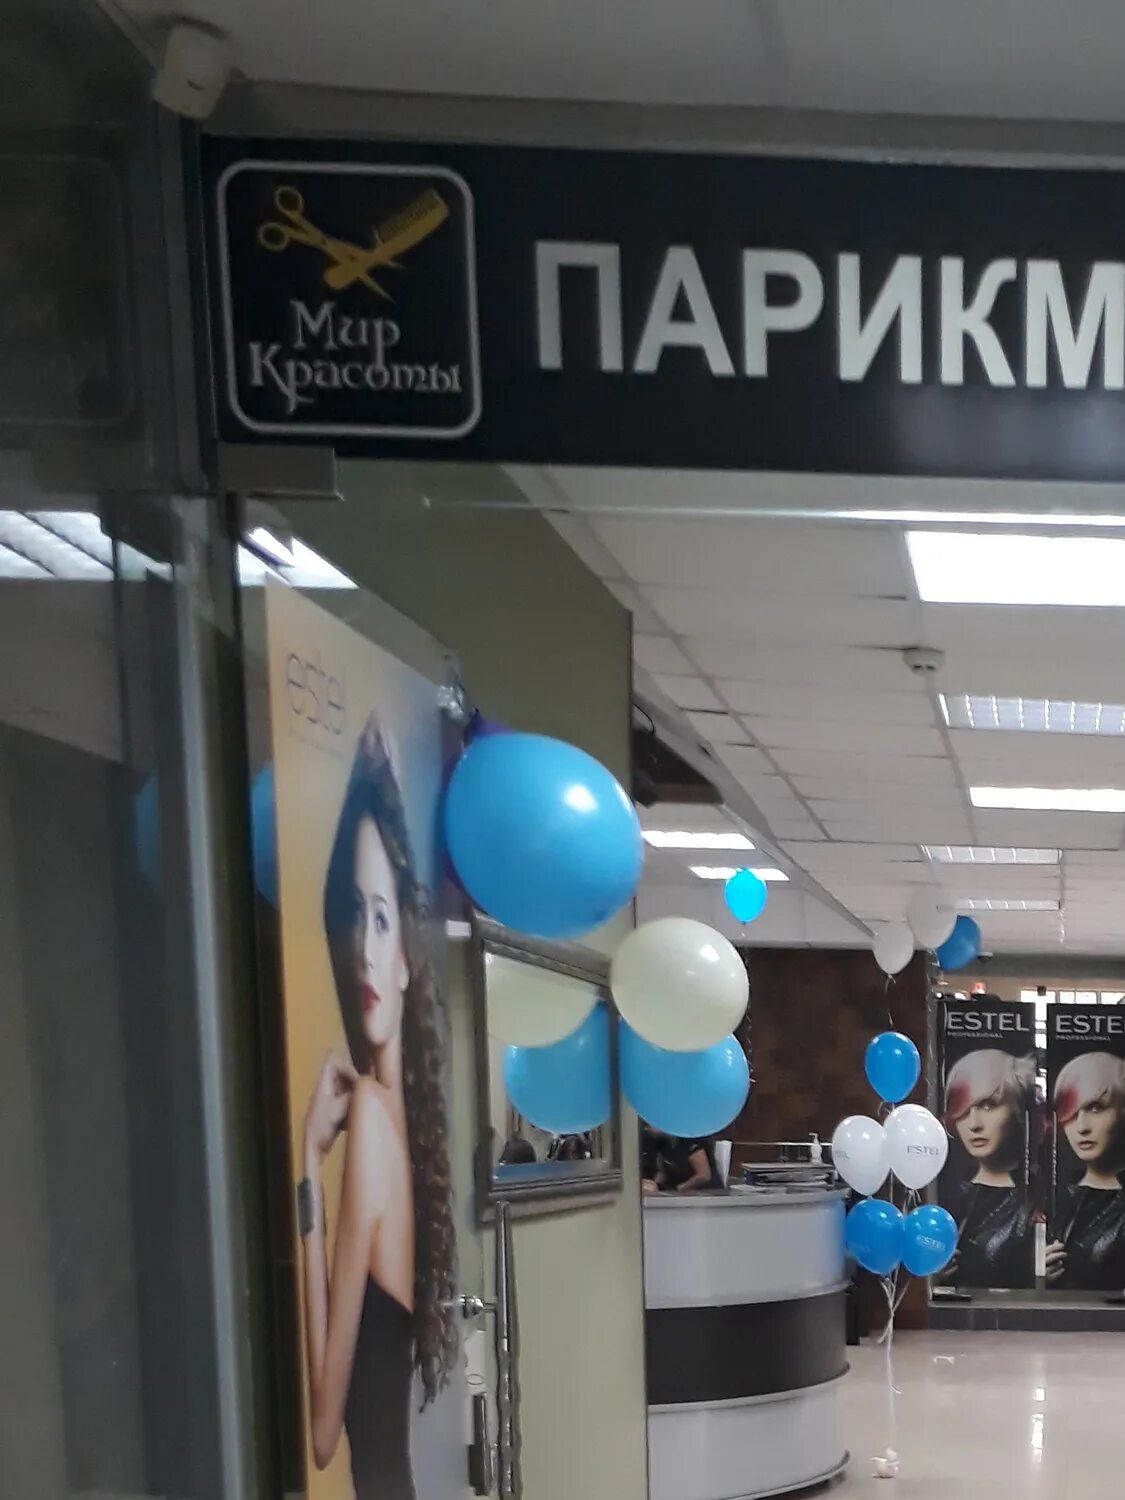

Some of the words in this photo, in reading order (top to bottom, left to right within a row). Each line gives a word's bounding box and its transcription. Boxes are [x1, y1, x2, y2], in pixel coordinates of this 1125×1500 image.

[290, 299, 400, 373] Мир
[249, 342, 462, 413] Красоты
[948, 1011, 1030, 1032] ESTEL
